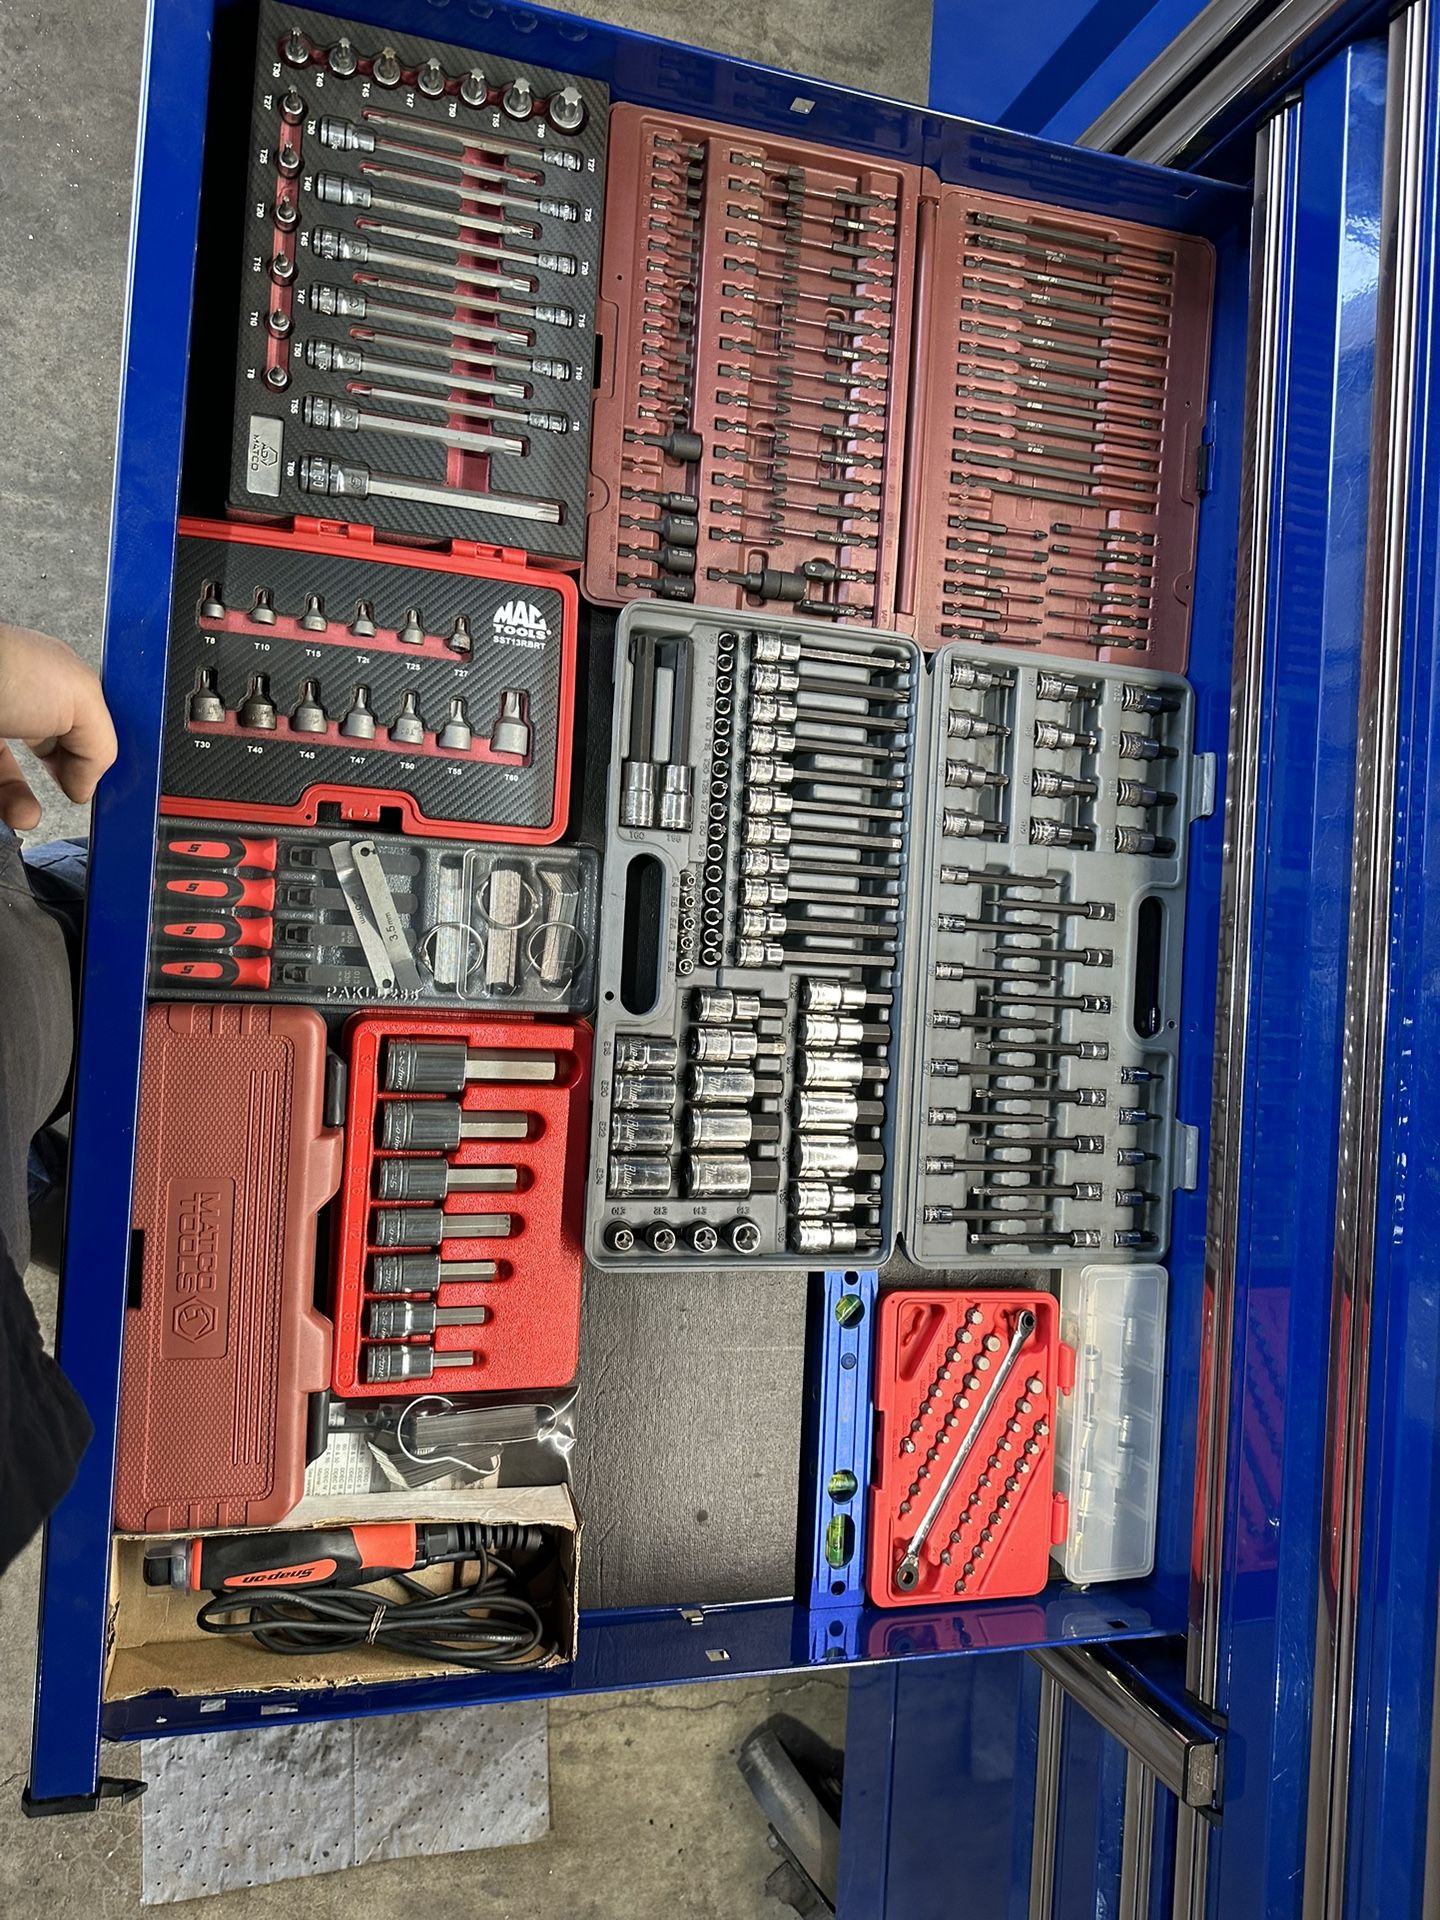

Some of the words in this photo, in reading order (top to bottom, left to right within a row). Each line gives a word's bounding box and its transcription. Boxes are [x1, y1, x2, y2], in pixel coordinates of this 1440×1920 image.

[272, 62, 281, 78] T30
[315, 72, 324, 88] T40
[361, 82, 371, 98] T45
[263, 95, 273, 111] T27
[406, 93, 415, 108] T47
[448, 102, 457, 118] T50
[307, 120, 317, 135] T30
[492, 113, 501, 128] T55
[537, 123, 546, 139] T60
[259, 149, 269, 164] T25
[587, 158, 595, 173] T27
[303, 176, 313, 192] T40
[256, 202, 265, 218] T20
[584, 207, 593, 223] T25
[300, 231, 309, 247] T45
[253, 256, 262, 272] T15
[581, 261, 589, 276] T20
[297, 289, 306, 305] T47
[249, 311, 259, 327] T10
[578, 313, 586, 328] T15
[293, 342, 303, 358] T50
[246, 368, 256, 379] T8
[575, 366, 583, 381] T10
[290, 398, 299, 414] T55
[572, 420, 580, 432] T8
[286, 461, 296, 477] T60
[492, 600, 547, 630] MAC
[492, 623, 547, 640] TOOLS
[204, 636, 216, 645] T8
[254, 642, 270, 651] T10
[492, 635, 547, 650] SST13RBRT
[305, 648, 322, 658] T15
[405, 662, 421, 671] T25
[453, 668, 469, 678] T27
[194, 740, 211, 749] T30
[247, 745, 263, 754] T40
[299, 750, 315, 760] T45
[349, 756, 366, 764] T47
[399, 761, 415, 770] T50
[447, 767, 462, 776] T55
[503, 773, 519, 782] T60
[385, 911, 399, 942] 3.5mm
[176, 1191, 200, 1294] TOOLS
[197, 1191, 221, 1294] MATCO
[242, 1567, 316, 1584] Snap-on
